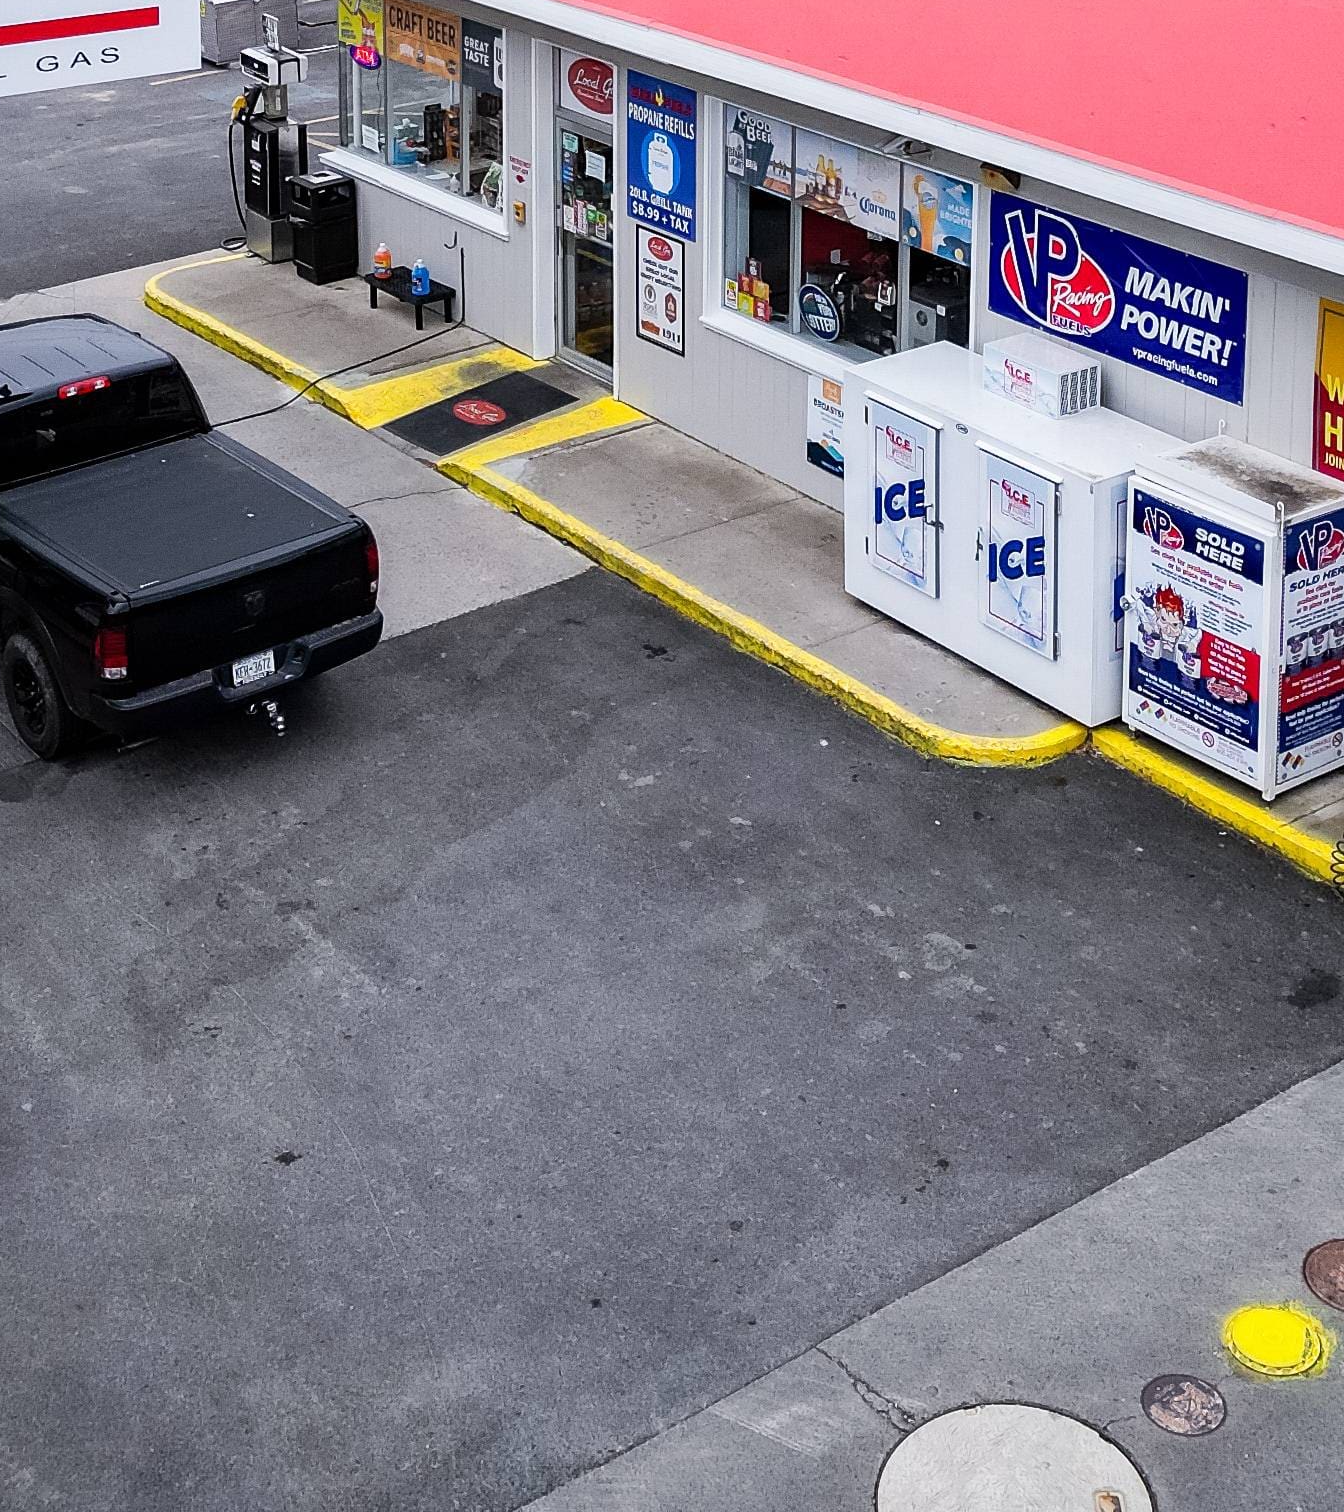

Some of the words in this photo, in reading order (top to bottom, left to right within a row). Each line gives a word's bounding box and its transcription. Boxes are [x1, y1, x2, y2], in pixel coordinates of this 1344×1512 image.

[389, 6, 424, 37] CRAFT
[426, 18, 456, 49] BEER
[35, 45, 122, 73] GAS
[463, 36, 490, 54] GREAT
[463, 48, 490, 67] TASTE
[573, 68, 601, 90] Local
[628, 102, 664, 130] PROPANE
[664, 114, 695, 141] REFILLS
[737, 109, 772, 134] GOOD
[632, 200, 660, 224] $8.99
[669, 213, 690, 235] TAX
[650, 193, 672, 211] GRILL
[672, 201, 693, 220] TANK
[859, 194, 897, 222] Corona
[1052, 282, 1113, 318] Racing
[1124, 266, 1230, 324] MAKIN'
[1052, 315, 1093, 338] FUELS
[1120, 304, 1232, 367] POWER!
[1132, 346, 1218, 386] vpracingfuels.com
[874, 478, 927, 524] ICE
[1195, 527, 1245, 556] SOLD
[1195, 541, 1244, 572] HERE
[988, 535, 1046, 583] ICE
[1289, 574, 1320, 593] SOLD
